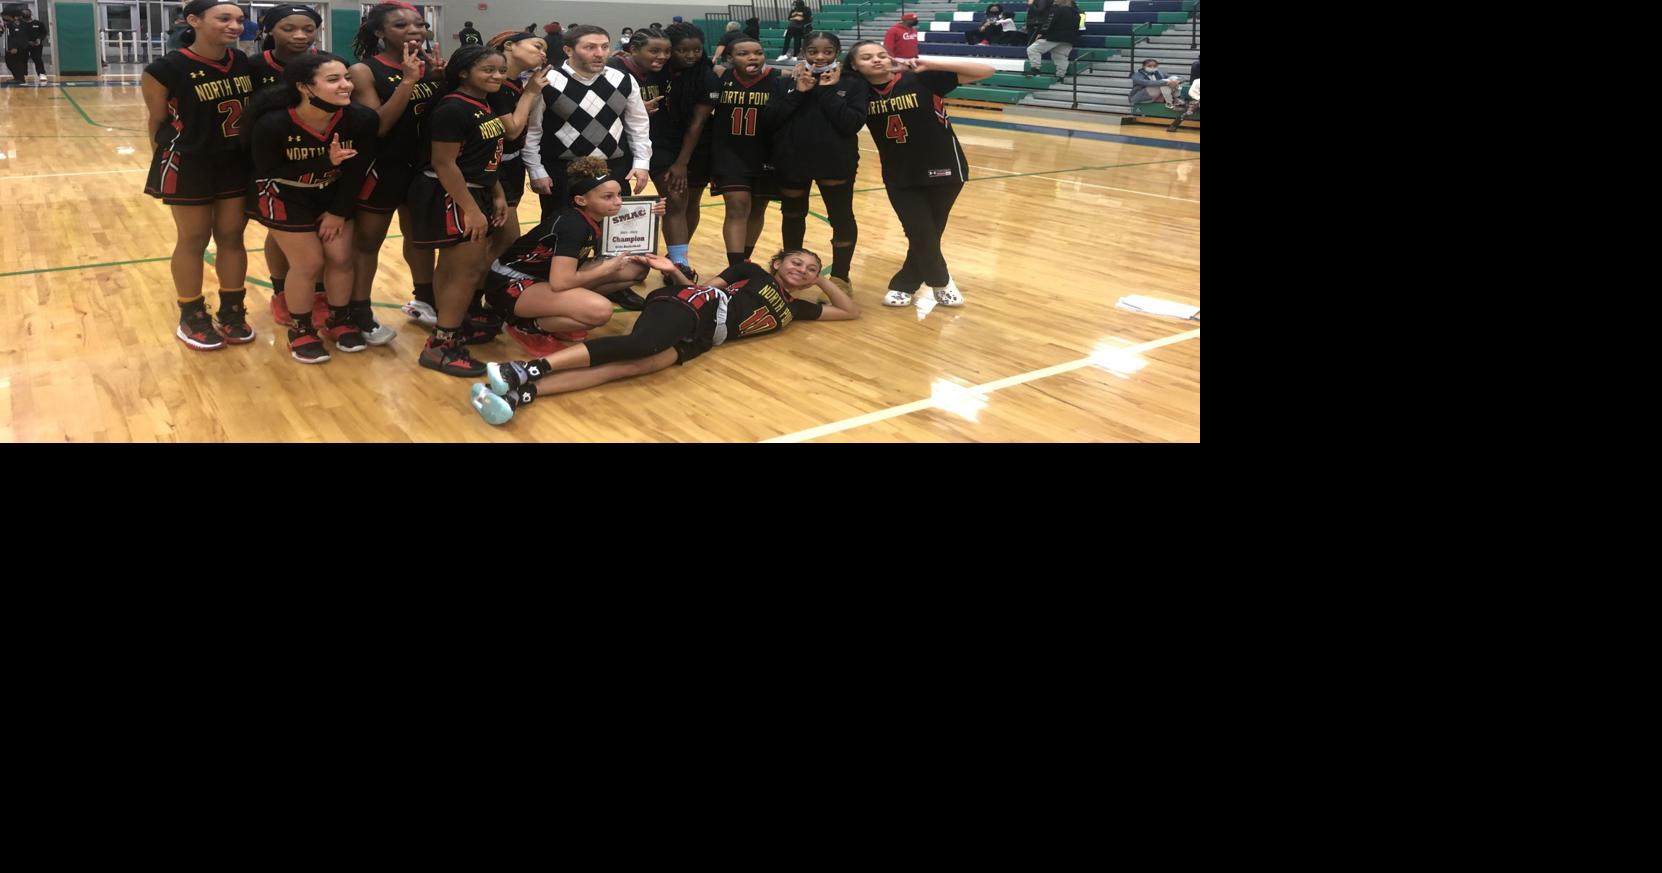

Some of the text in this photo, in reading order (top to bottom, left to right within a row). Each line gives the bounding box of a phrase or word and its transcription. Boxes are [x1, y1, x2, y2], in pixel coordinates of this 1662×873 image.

[194, 78, 233, 102] NORTH
[748, 91, 770, 105] POIN
[890, 93, 919, 112] POINT
[731, 106, 758, 136] 11
[885, 113, 908, 144] 4
[612, 208, 647, 225] SMAC
[612, 235, 645, 244] Champion
[758, 284, 786, 313] NORTH
